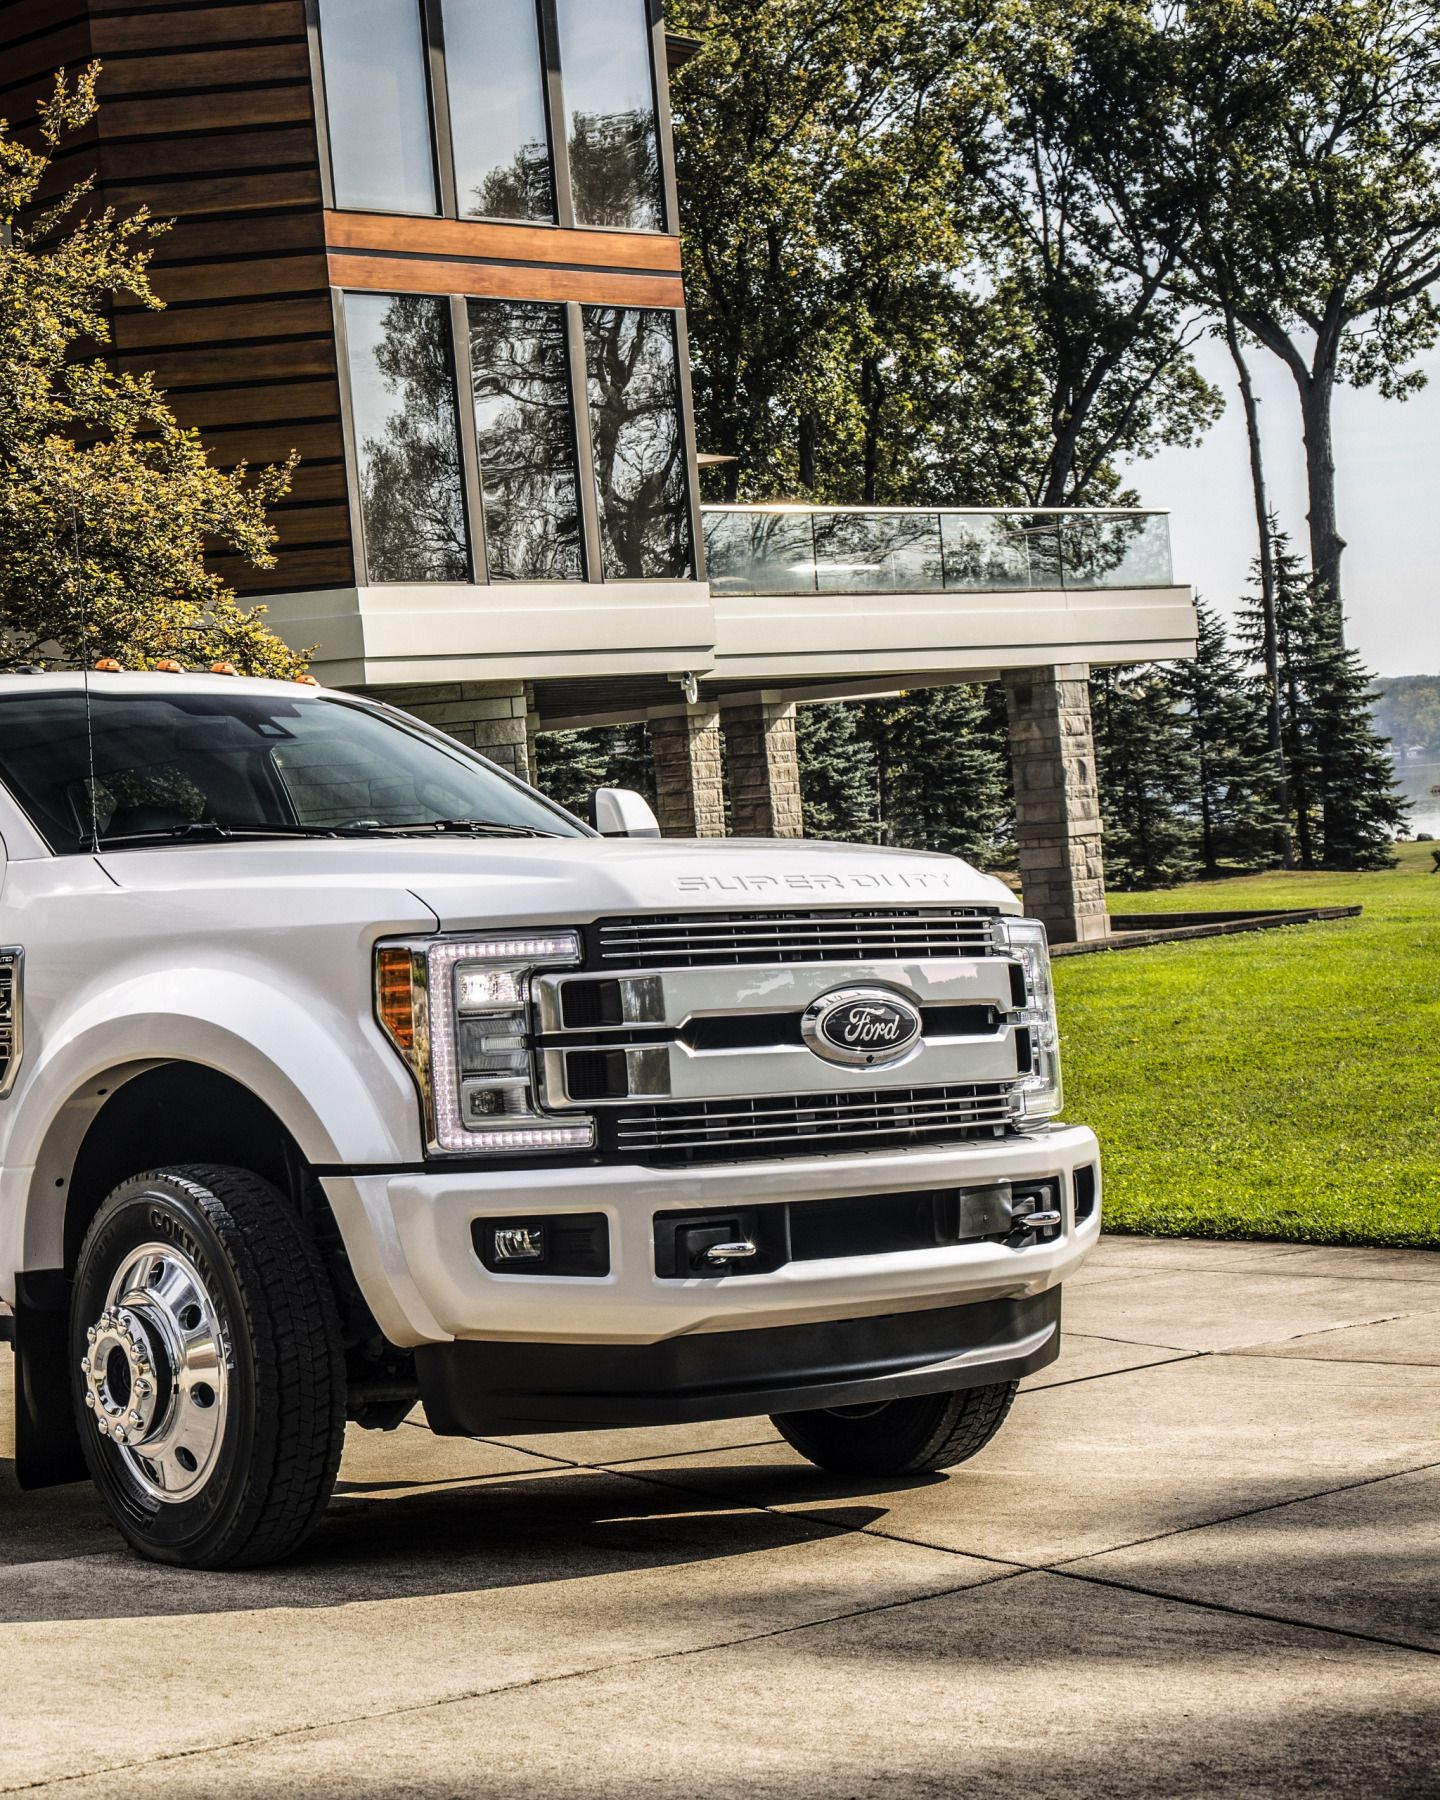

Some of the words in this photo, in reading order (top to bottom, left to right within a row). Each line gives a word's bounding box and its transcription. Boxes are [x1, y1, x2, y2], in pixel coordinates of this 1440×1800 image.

[673, 874, 845, 892] SUPER
[847, 873, 951, 889] DUTY
[844, 1007, 900, 1042] Ford
